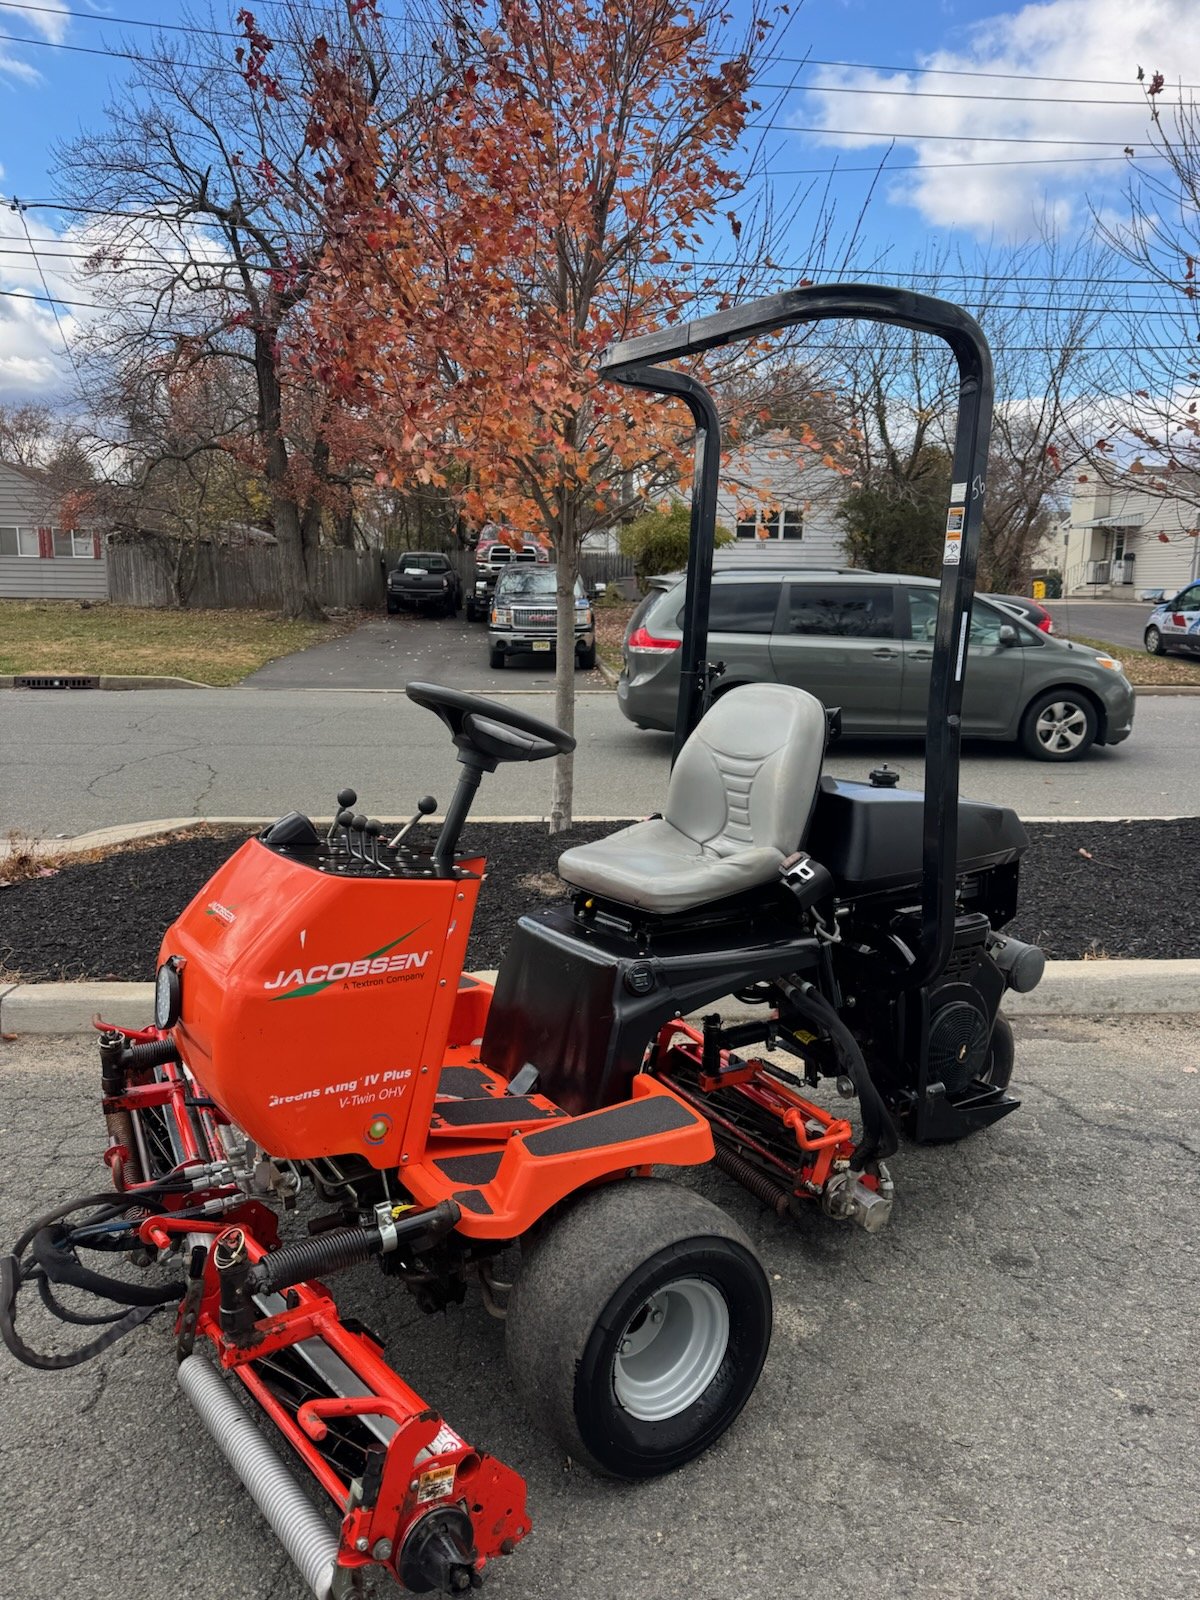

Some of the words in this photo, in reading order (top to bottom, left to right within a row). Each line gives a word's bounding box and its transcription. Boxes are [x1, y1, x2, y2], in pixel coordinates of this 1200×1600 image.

[263, 951, 430, 990] JACOBSEN
[343, 982, 350, 991] A
[352, 978, 384, 989] Textron
[386, 972, 425, 985] Company
[364, 1073, 380, 1087] IV
[383, 1068, 412, 1083] Plus
[339, 1093, 376, 1109] V-Twin
[378, 1084, 407, 1101] OHV
